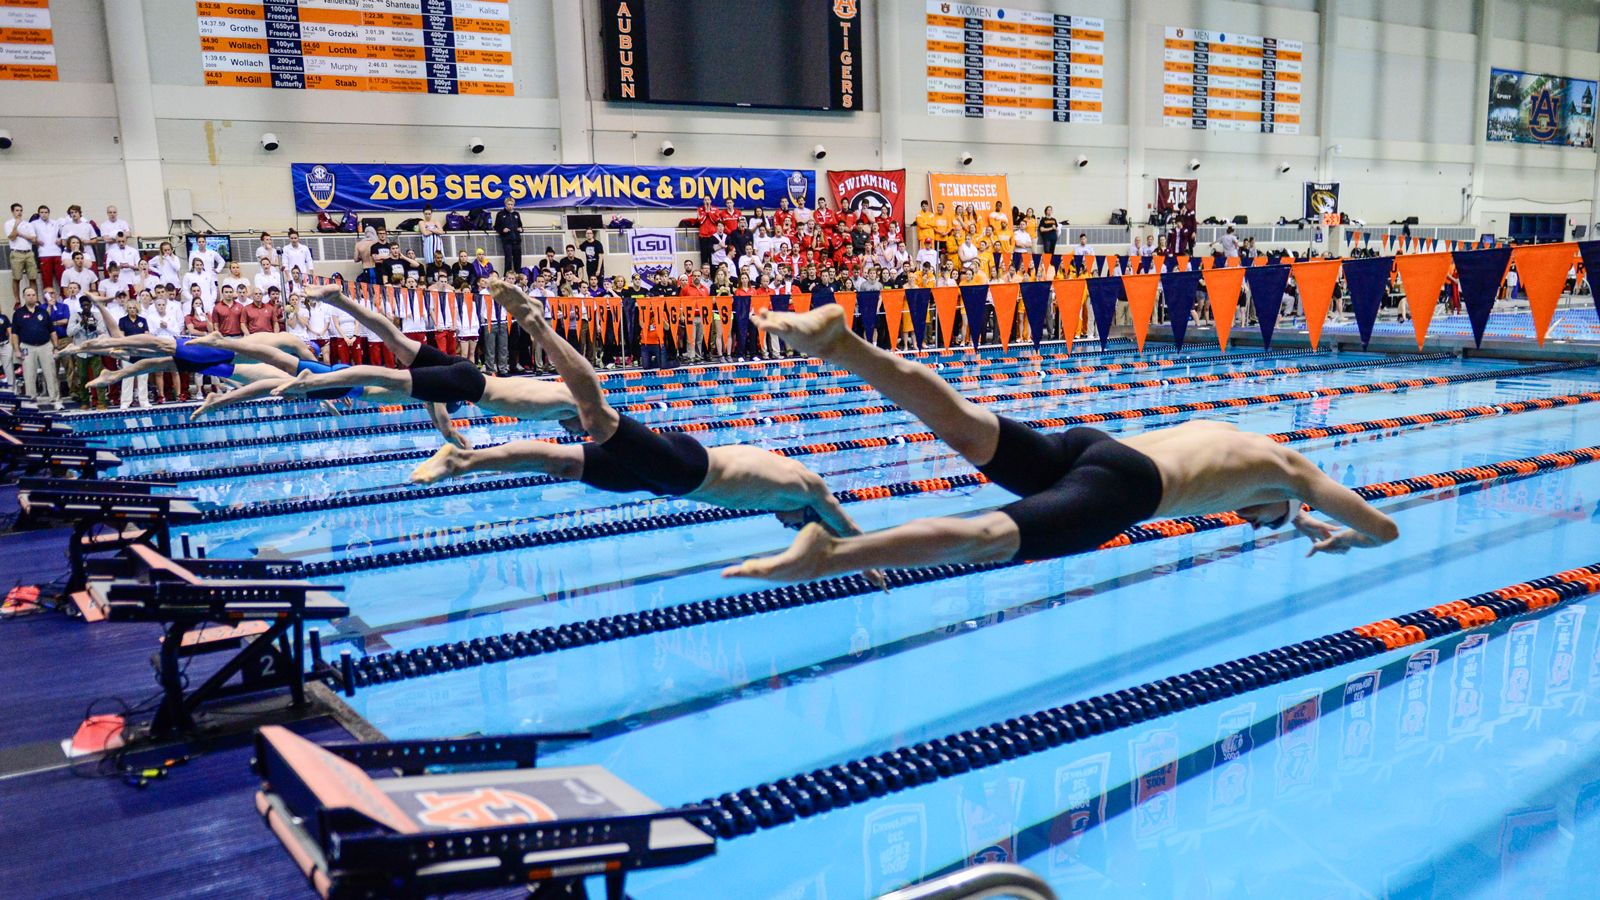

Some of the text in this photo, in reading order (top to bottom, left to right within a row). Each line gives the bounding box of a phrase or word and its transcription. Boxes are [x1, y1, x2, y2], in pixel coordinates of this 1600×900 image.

[386, 0, 420, 9] Shanteau
[227, 7, 256, 16] Grothe
[957, 6, 992, 18] WOMEN
[230, 24, 258, 32] Grothe
[328, 30, 358, 38] Grodzki
[1194, 32, 1210, 40] MEN
[228, 42, 262, 50] Wollach
[328, 46, 358, 54] Lochte
[617, 2, 635, 98] AUBURN
[230, 59, 264, 68] Wollach
[330, 62, 358, 72] Murphy
[840, 22, 852, 108] TIGERS
[236, 76, 262, 84] McGill
[368, 174, 764, 200] 2015 SEC SWIMMING & DIVING
[838, 174, 898, 196] SWIMMING
[940, 182, 998, 196] TENNESSEE
[638, 240, 666, 251] LSU
[260, 654, 276, 676] 2
